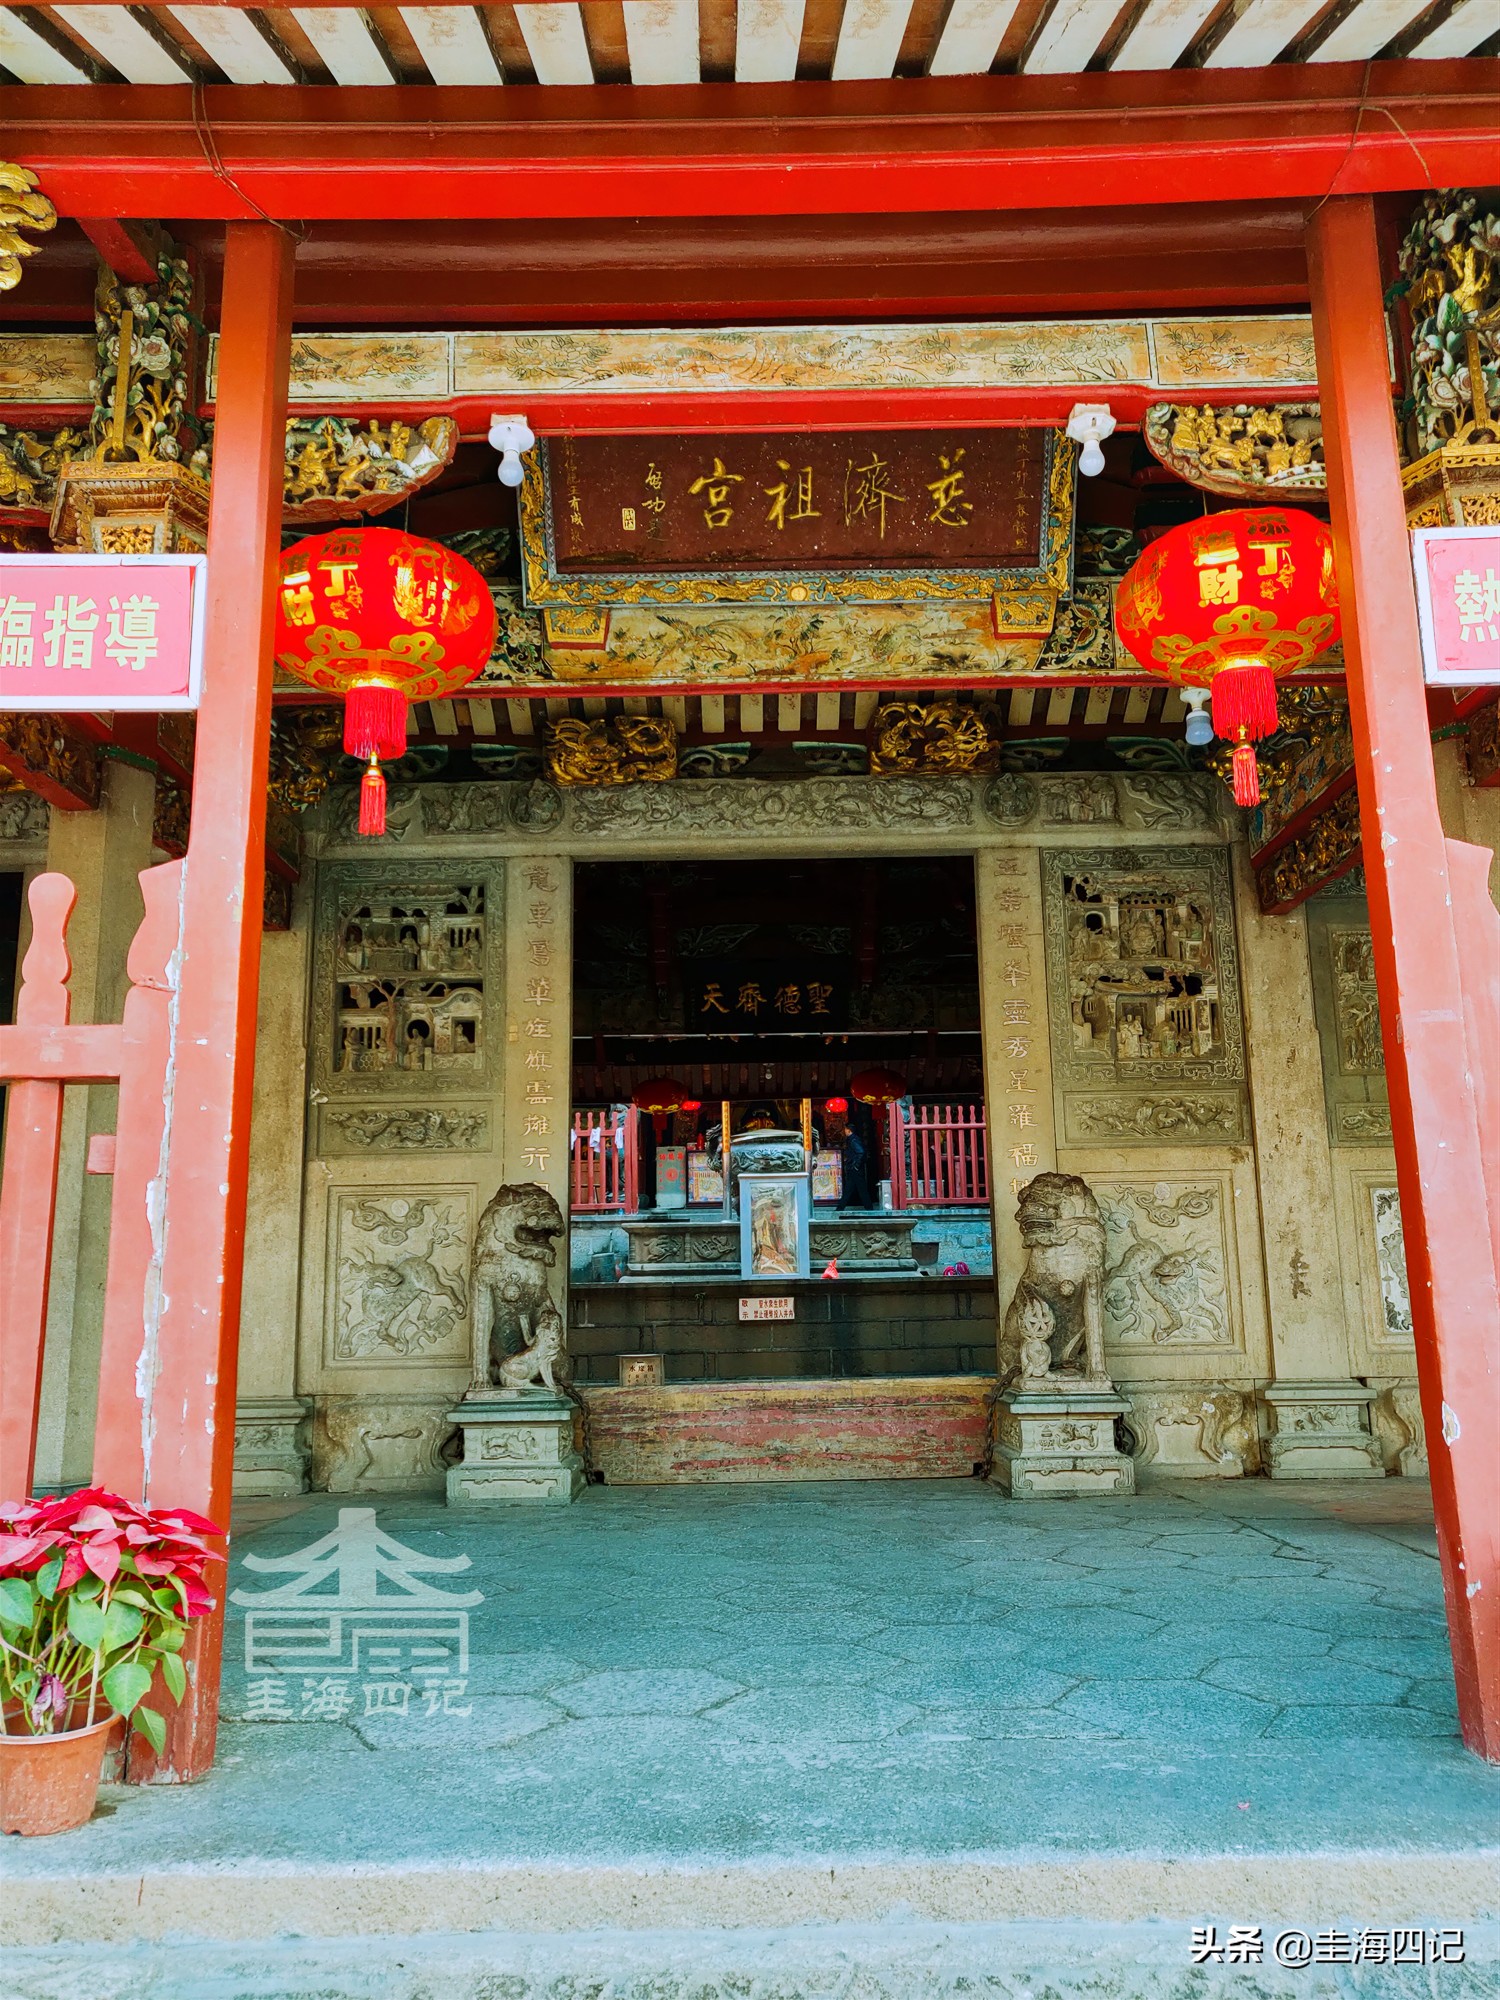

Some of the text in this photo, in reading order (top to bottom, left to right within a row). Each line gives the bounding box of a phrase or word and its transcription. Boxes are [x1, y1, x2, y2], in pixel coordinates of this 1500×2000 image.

[520, 864, 558, 1193] 龍車鳳輦旌旗雲擁行
